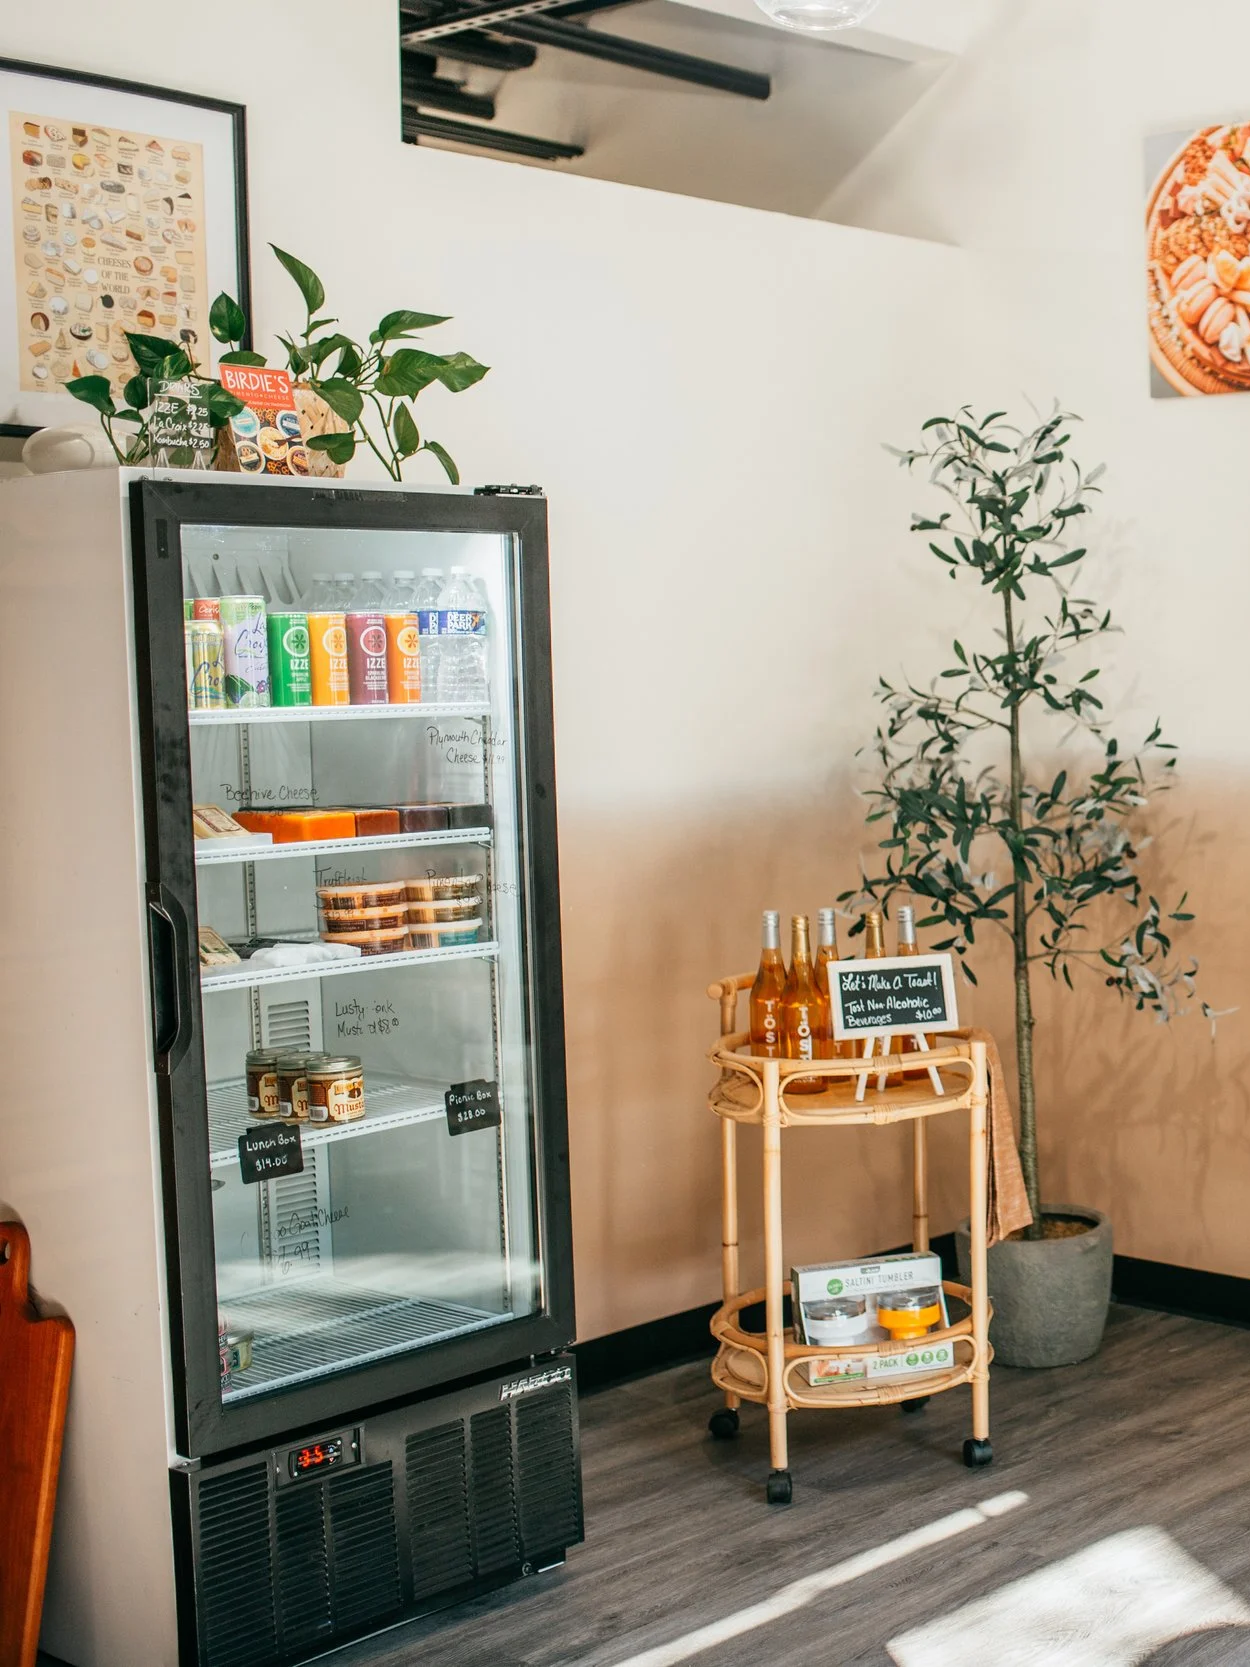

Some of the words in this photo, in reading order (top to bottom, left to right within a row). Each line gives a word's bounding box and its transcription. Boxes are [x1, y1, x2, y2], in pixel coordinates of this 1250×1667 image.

[97, 256, 132, 269] CHEESES
[101, 270, 112, 280] OF
[114, 271, 129, 281] THE
[101, 282, 130, 294] WORLD
[225, 370, 289, 394] BIRDIE'S
[153, 434, 189, 447] Kombucha
[447, 612, 472, 621] DEER
[447, 620, 473, 631] PARK
[290, 659, 309, 670] IZZE
[329, 658, 347, 670] IZZE
[366, 658, 386, 669] IZZE
[426, 726, 470, 749] Plymouth
[446, 747, 481, 764] Cheese
[279, 785, 320, 801] Cheese
[842, 972, 866, 991] Let's
[868, 974, 892, 992] Make
[893, 976, 903, 990] A
[335, 999, 365, 1020] Lusty
[844, 999, 865, 1015] Tost
[845, 1013, 892, 1027] Beverages
[475, 1089, 492, 1101] Box
[246, 1138, 276, 1152] Lunch
[277, 1134, 297, 1146] Box
[878, 1271, 914, 1284] TUMBLER
[878, 1358, 898, 1369] PACK
